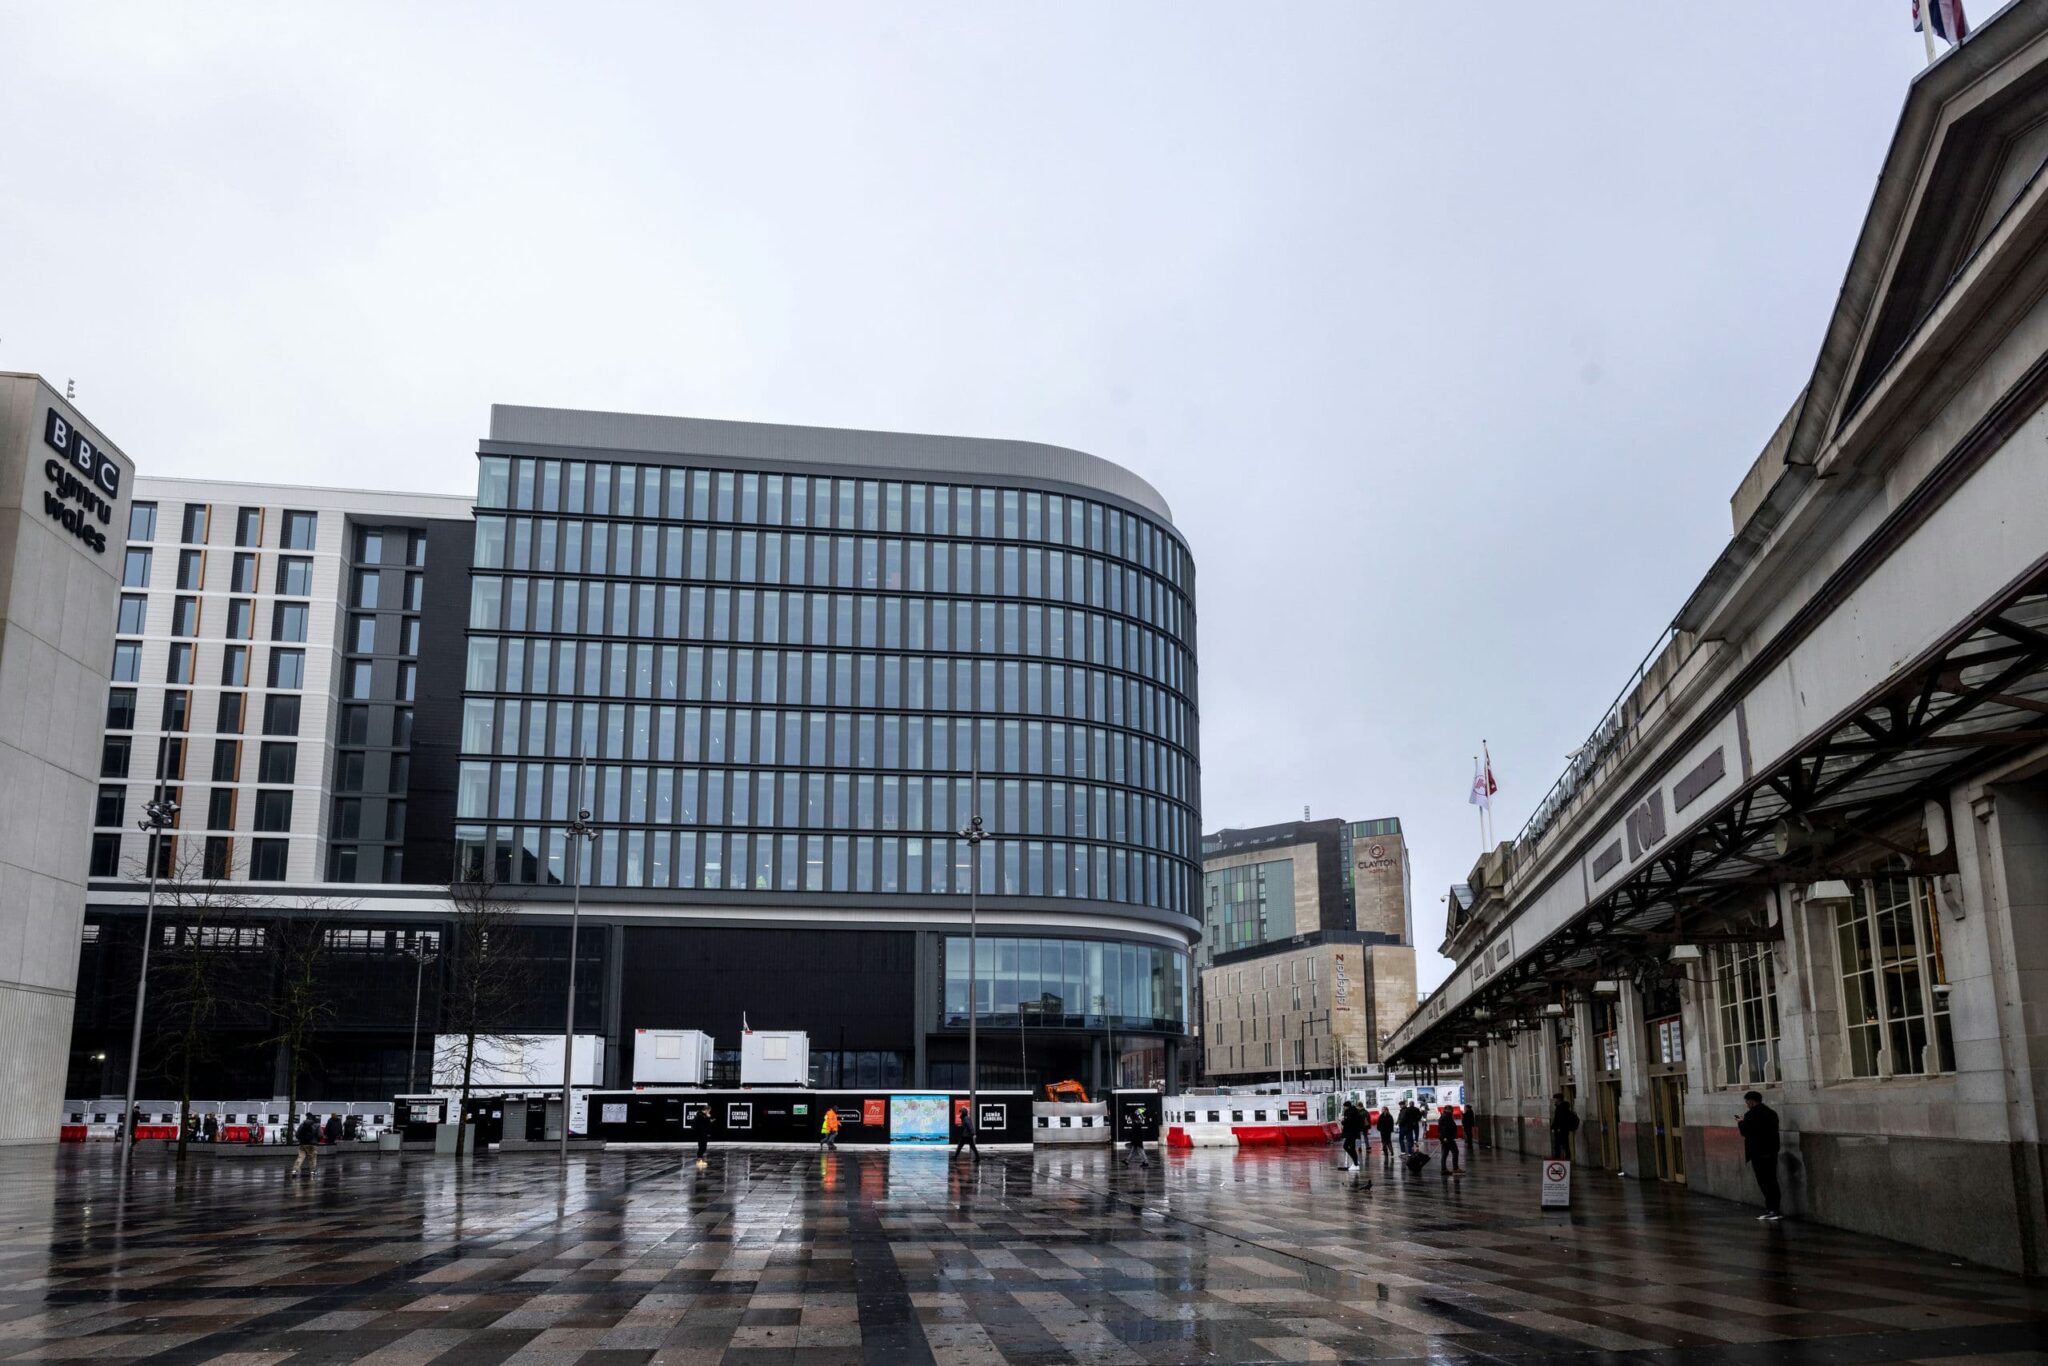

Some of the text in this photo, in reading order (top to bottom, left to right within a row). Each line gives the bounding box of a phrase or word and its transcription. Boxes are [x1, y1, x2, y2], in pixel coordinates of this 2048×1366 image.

[53, 416, 117, 492] BBC
[44, 491, 106, 554] wales
[45, 459, 112, 525] cymru
[1358, 859, 1397, 869] CLAYTON
